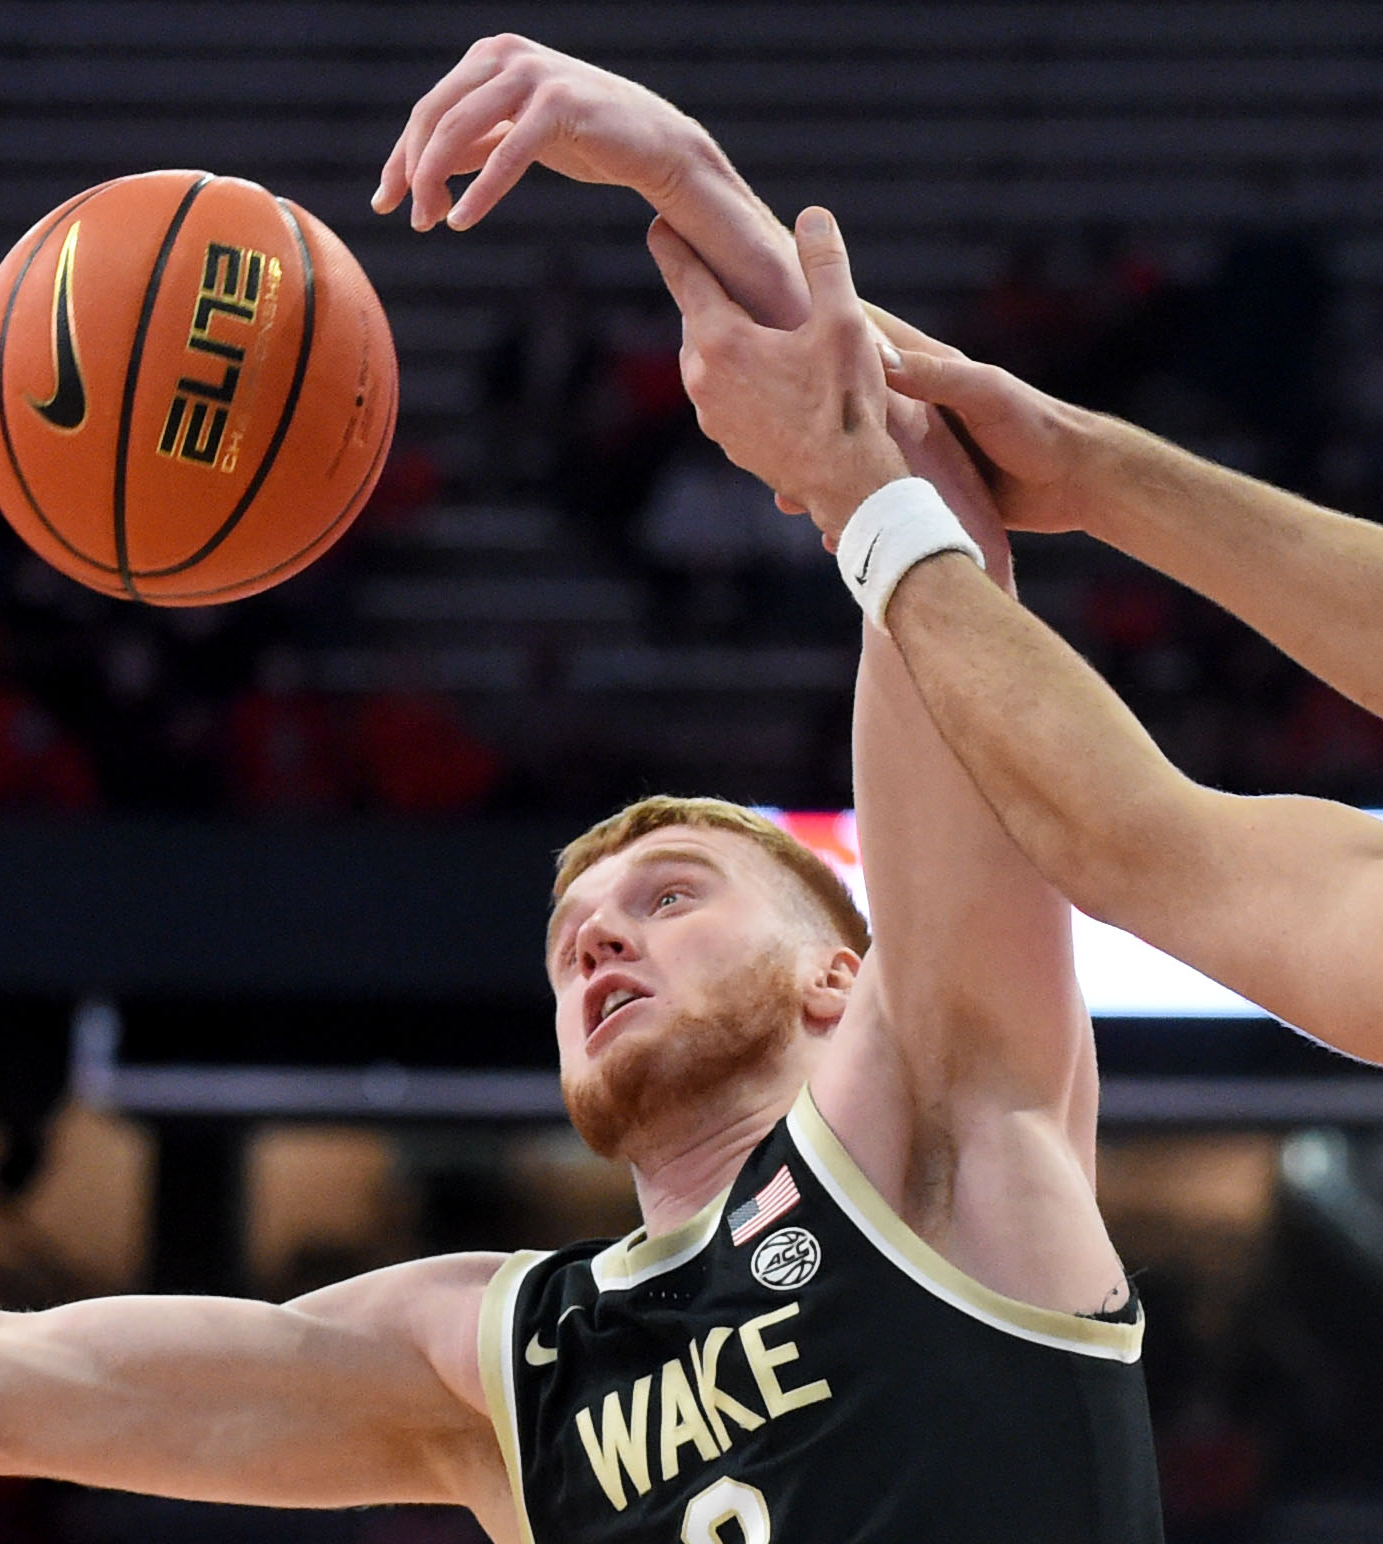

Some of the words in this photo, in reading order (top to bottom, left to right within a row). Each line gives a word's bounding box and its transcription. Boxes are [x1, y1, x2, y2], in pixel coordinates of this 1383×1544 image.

[157, 241, 266, 467] ELITE
[764, 1237, 810, 1271] ACC
[575, 1303, 832, 1511] WAKE
